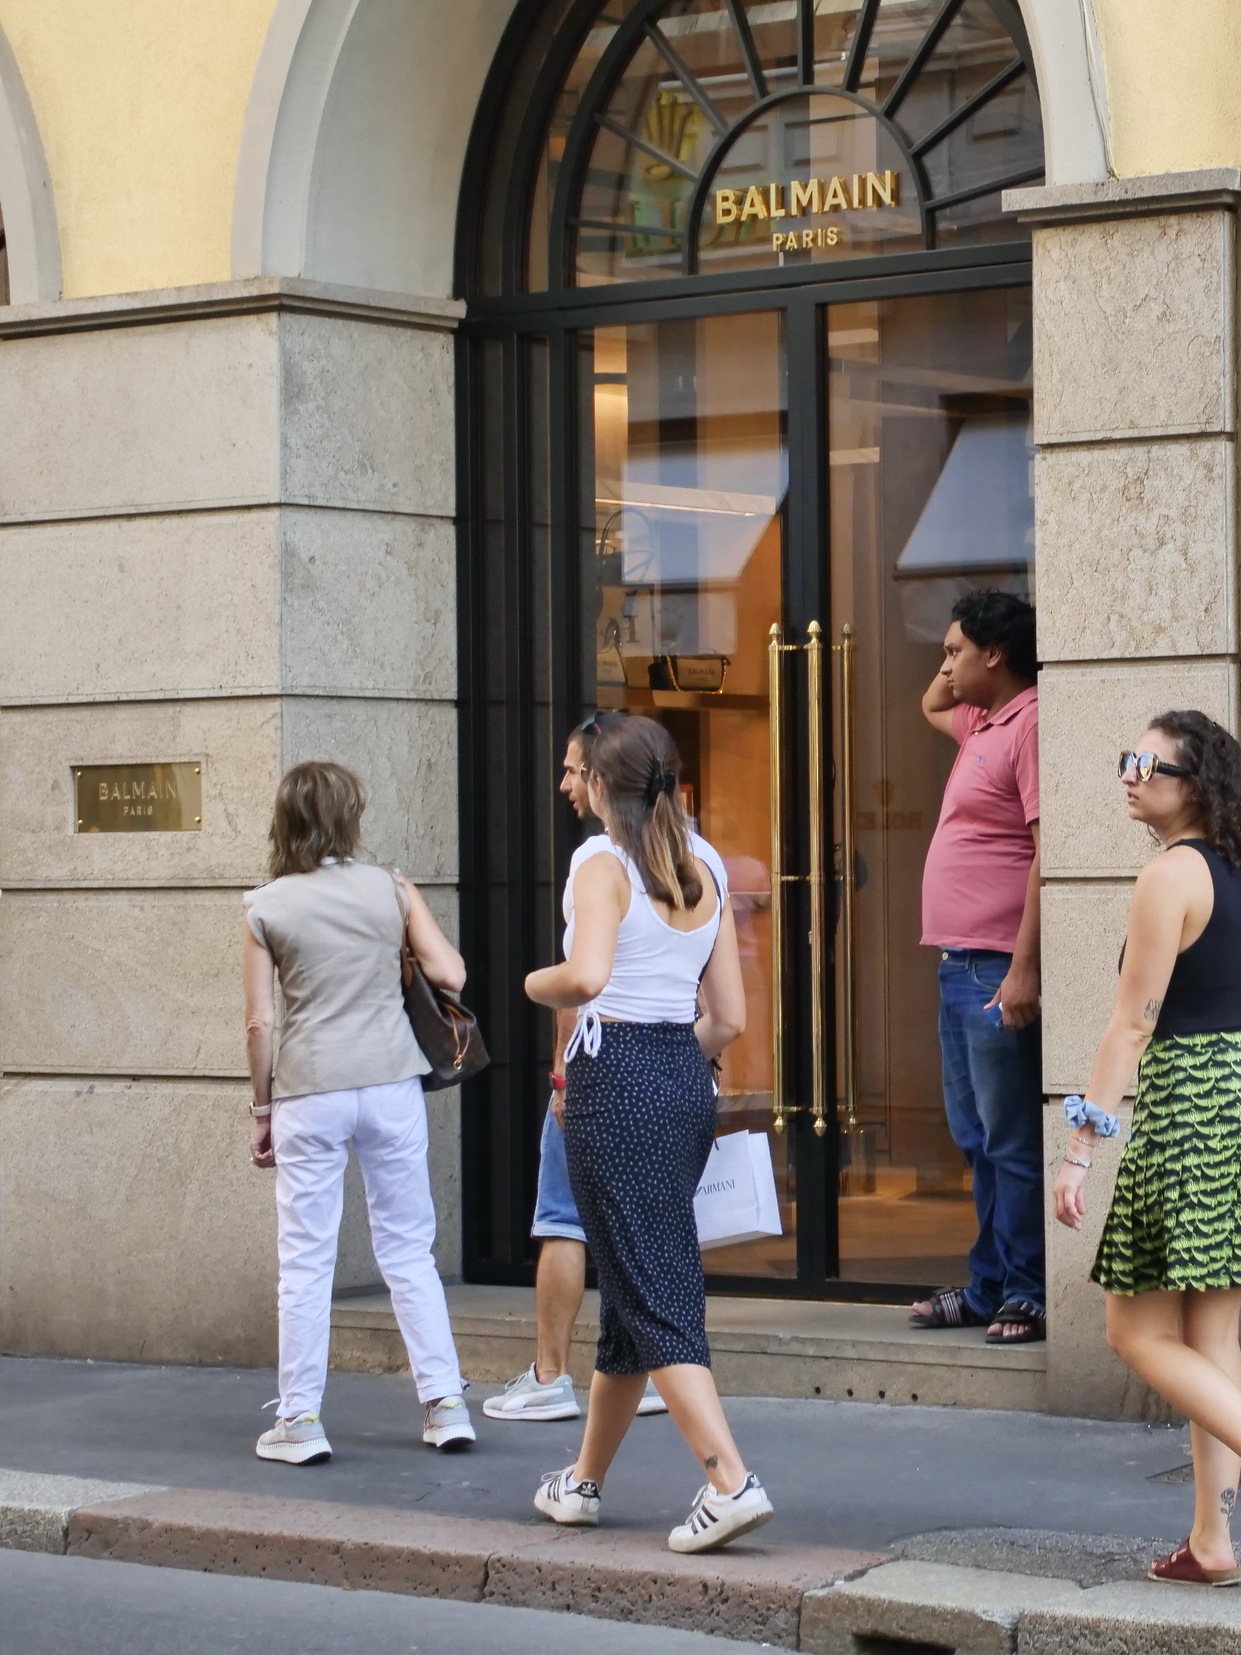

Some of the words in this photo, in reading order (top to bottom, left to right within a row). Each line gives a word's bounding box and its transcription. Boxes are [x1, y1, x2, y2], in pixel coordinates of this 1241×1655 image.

[715, 169, 899, 225] BALMAIN
[772, 227, 839, 252] PARIS
[98, 780, 178, 801] BALMAIN
[122, 805, 154, 816] PARIS
[701, 1179, 735, 1195] ARMANI
